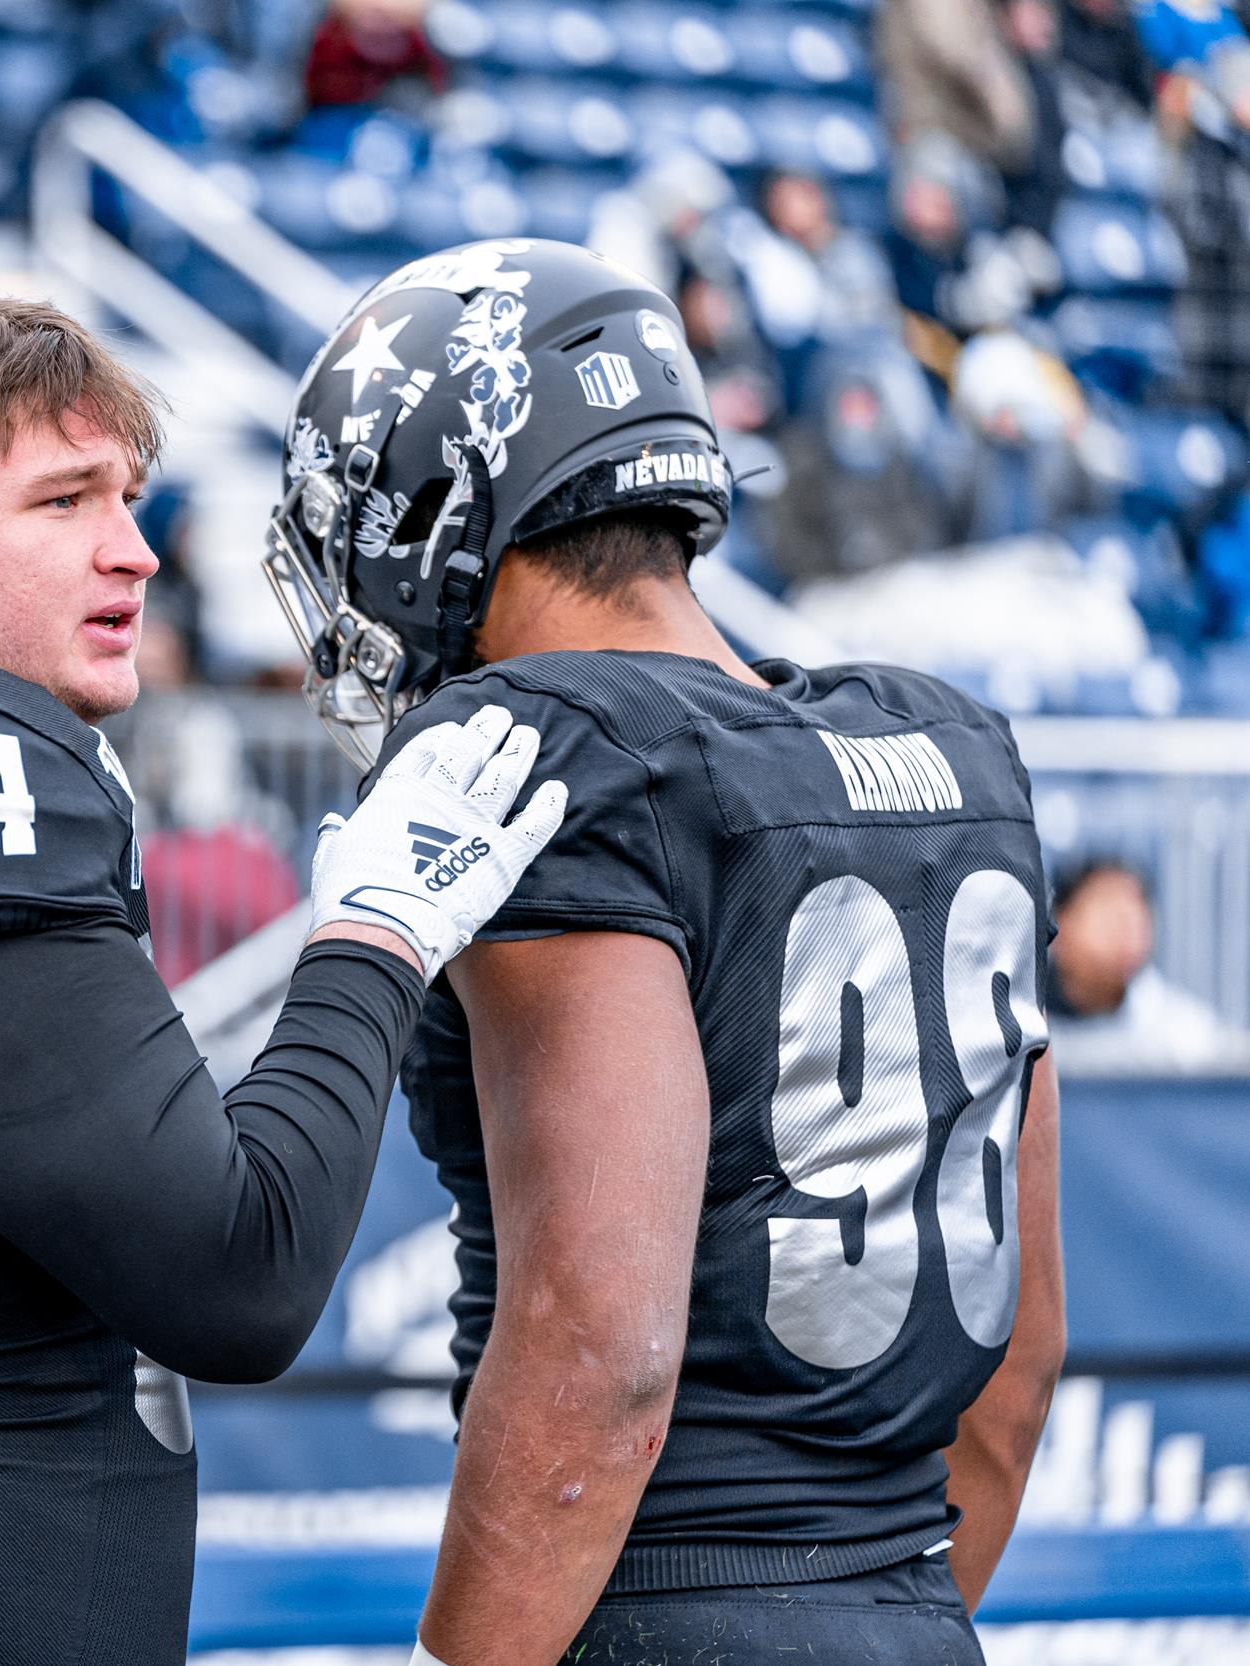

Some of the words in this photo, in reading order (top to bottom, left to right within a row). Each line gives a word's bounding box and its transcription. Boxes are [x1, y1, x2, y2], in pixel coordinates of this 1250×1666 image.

[615, 453, 709, 493] NEVADA
[816, 729, 963, 813] HAMMOND
[425, 836, 490, 892] adidas
[765, 869, 1048, 1370] 98
